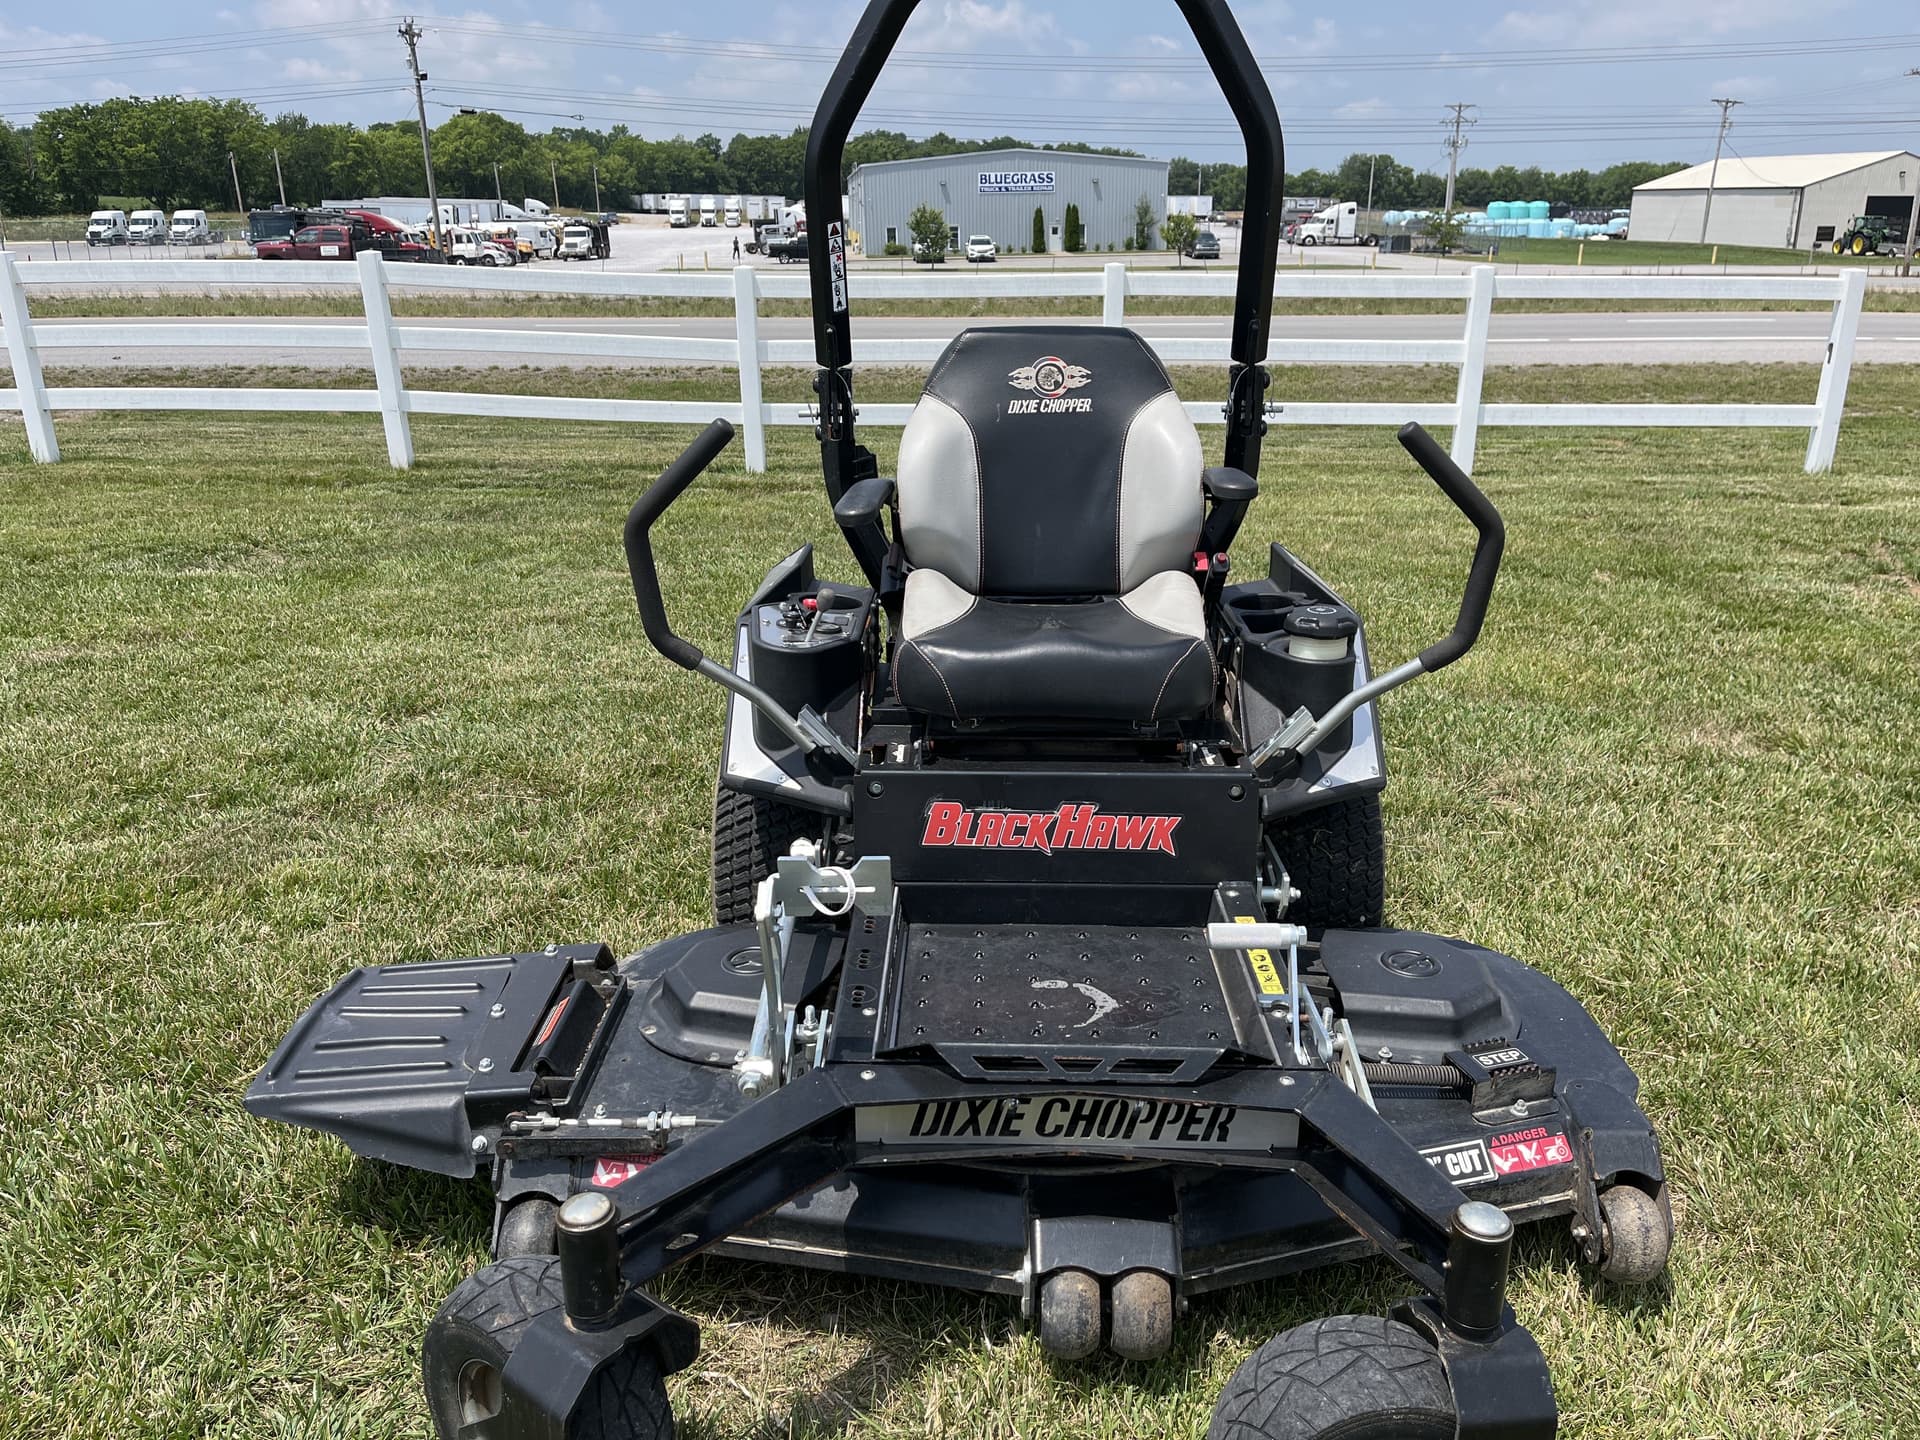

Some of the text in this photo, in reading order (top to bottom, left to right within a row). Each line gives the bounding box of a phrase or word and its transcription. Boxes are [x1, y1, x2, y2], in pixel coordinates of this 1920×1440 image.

[980, 173, 1053, 184] BLUEGRASS
[1008, 398, 1091, 414] DIXIE CHOPPER
[1479, 1049, 1521, 1066] STEP
[909, 1097, 1237, 1142] DIXIE CHOPPER
[1500, 1127, 1547, 1144] DANGER
[1444, 1148, 1483, 1176] CUT
